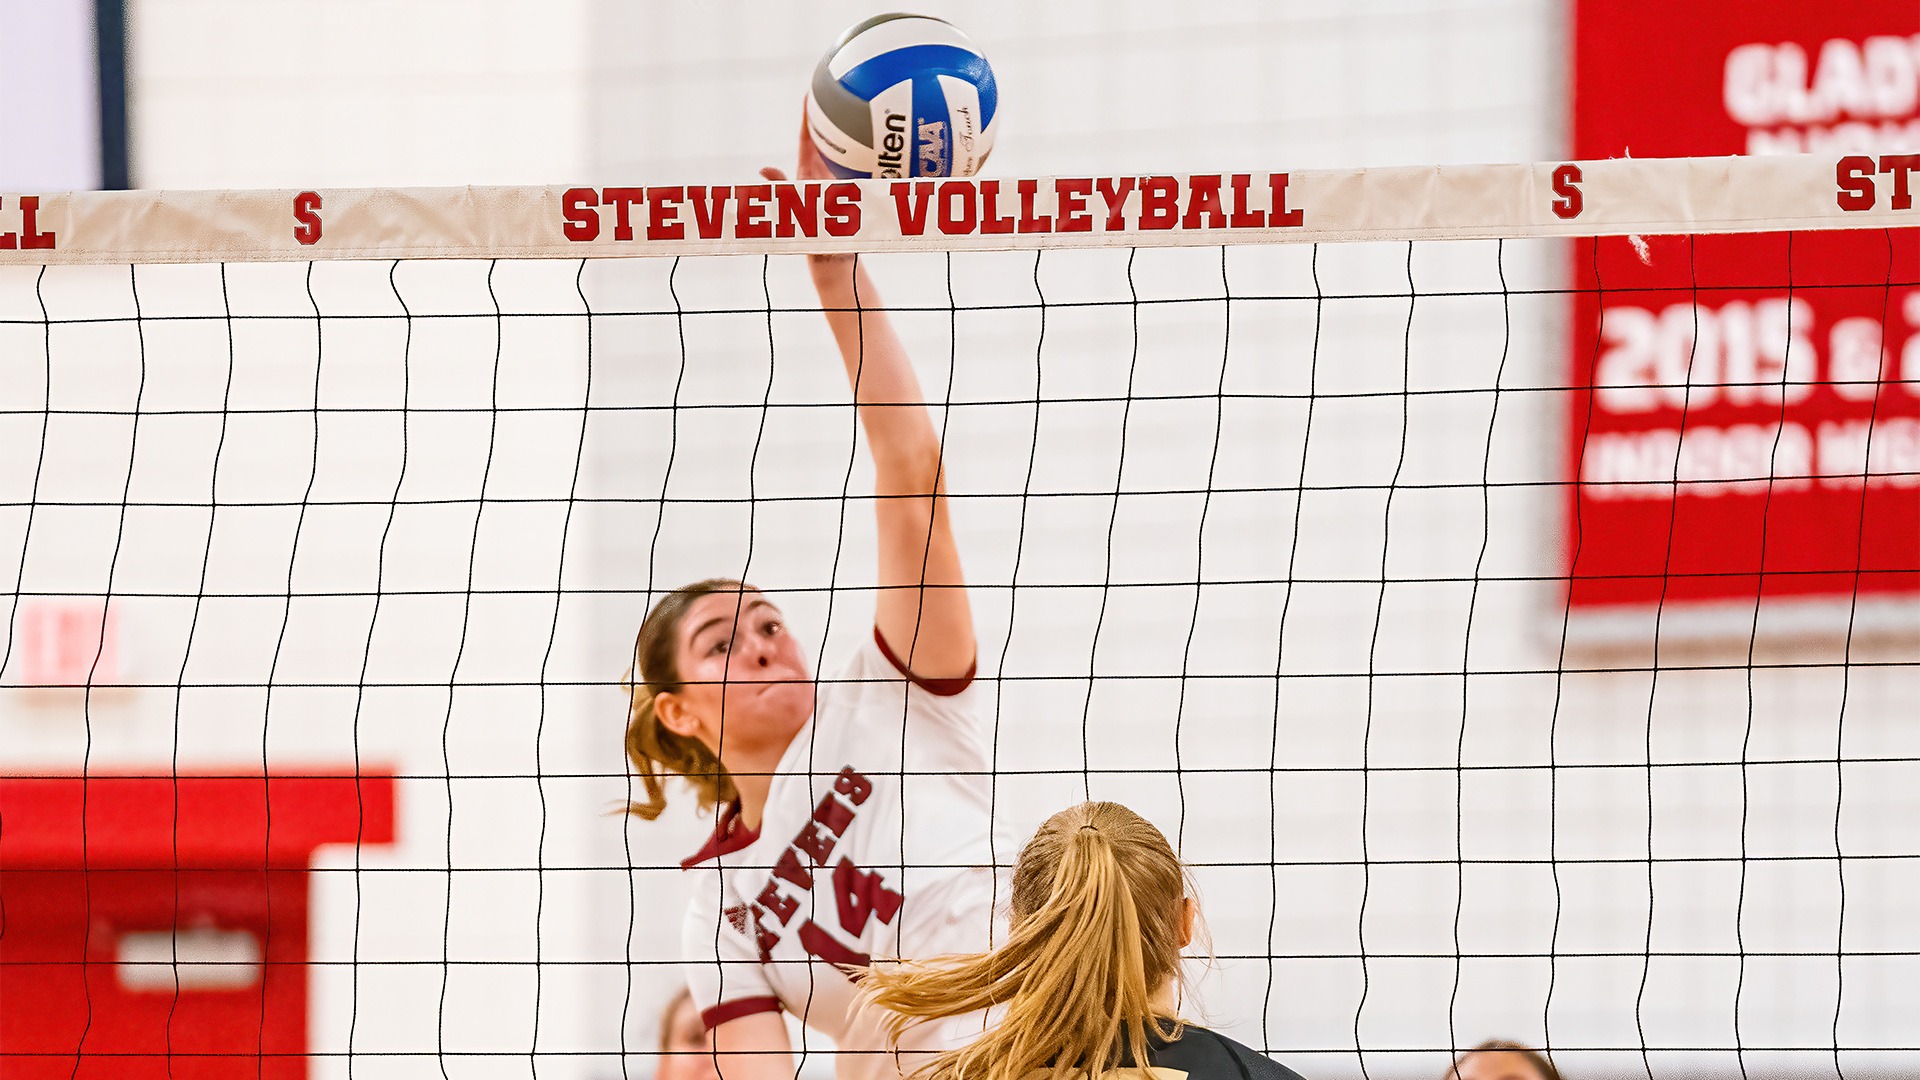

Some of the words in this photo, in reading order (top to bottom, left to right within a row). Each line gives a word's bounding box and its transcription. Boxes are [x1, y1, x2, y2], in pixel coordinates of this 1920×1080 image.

[1725, 35, 1920, 125] GLAD
[562, 182, 862, 242] STEVENS
[889, 173, 1304, 236] VOLLEYBALL
[1551, 163, 1583, 219] S
[1836, 154, 1920, 211] ST
[293, 190, 323, 245] S
[1597, 297, 1818, 414] 2015
[797, 855, 905, 984] 14
